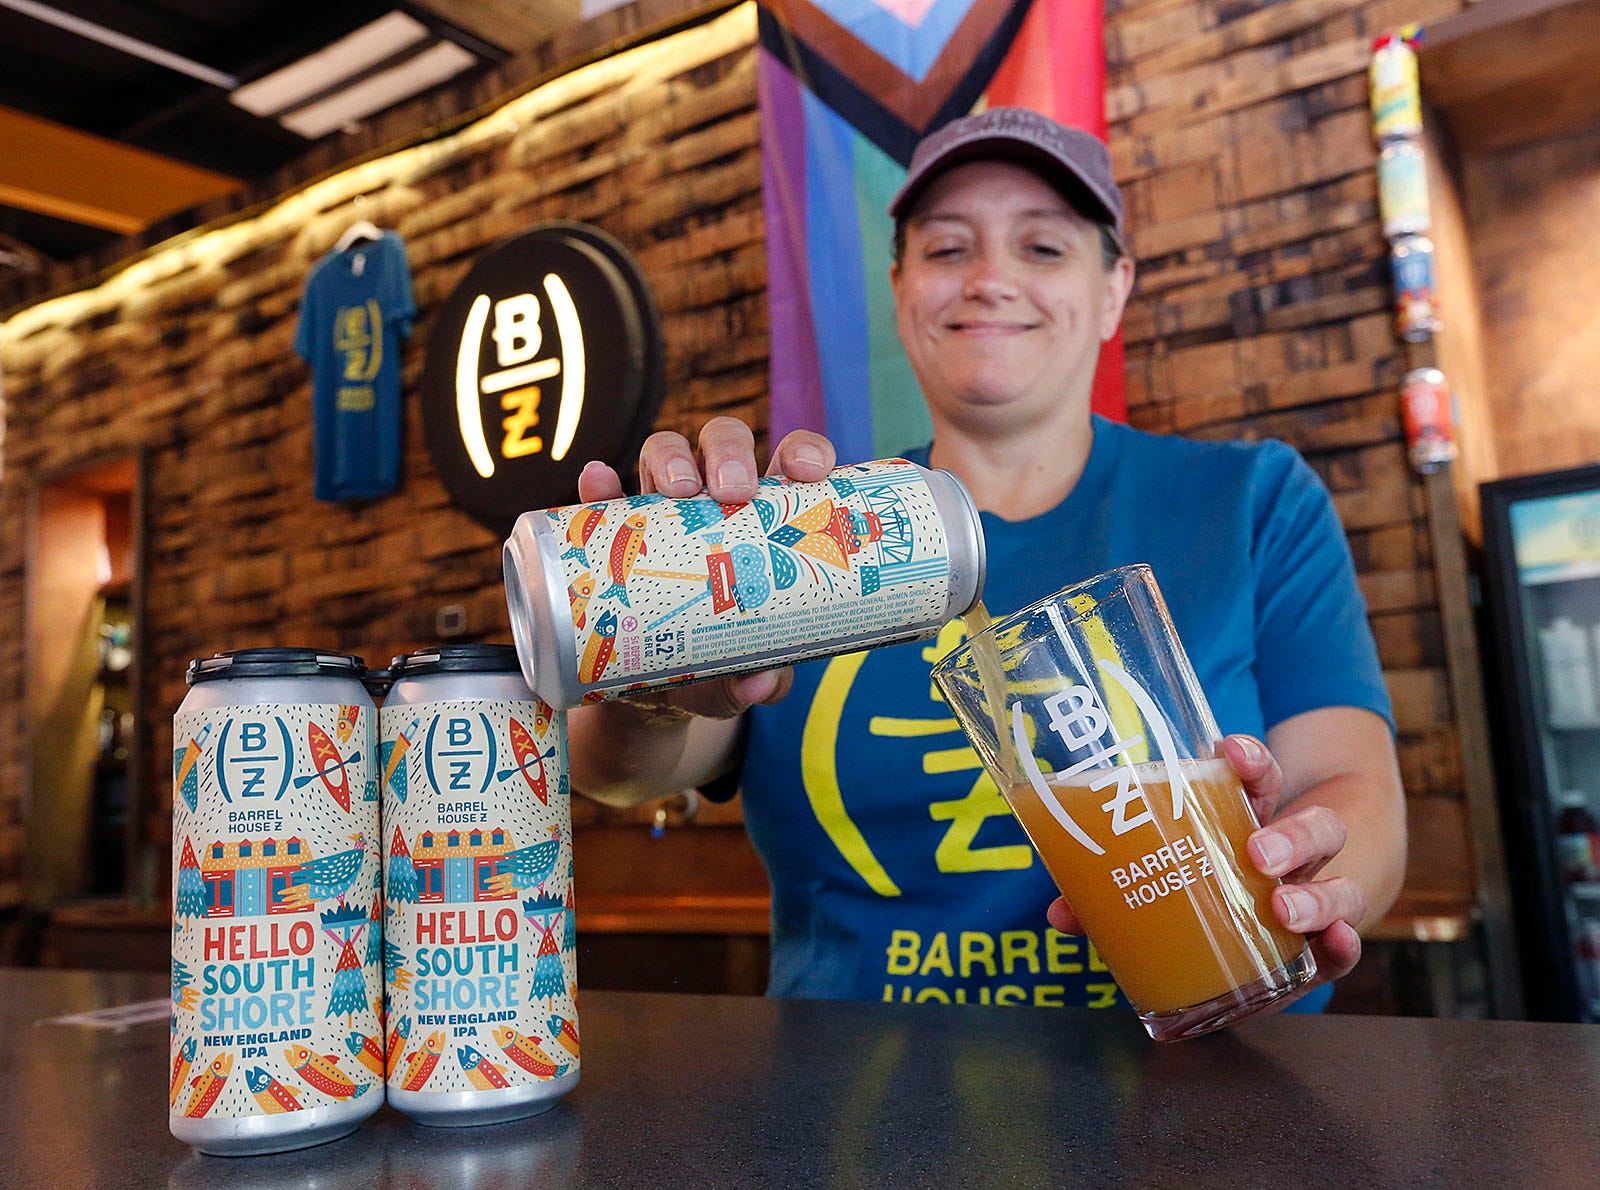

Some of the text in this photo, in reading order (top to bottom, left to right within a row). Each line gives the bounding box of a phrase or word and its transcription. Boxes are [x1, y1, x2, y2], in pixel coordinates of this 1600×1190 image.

[491, 292, 543, 367] B
[500, 386, 544, 460] Z
[692, 622, 735, 634] GOVERNMENT
[736, 616, 768, 626] WARNING:
[778, 609, 810, 619] ACCORDING
[832, 600, 858, 610] SURGEON
[860, 596, 885, 605] GENERAL,
[887, 592, 908, 601] WOMEN
[909, 588, 931, 597] SHOULD
[724, 627, 756, 637] ALCOHOLIC
[758, 620, 791, 632] BEVERAGES
[792, 617, 814, 626] DURING
[814, 610, 848, 621] PREGNANCY
[850, 606, 874, 616] BECAUSE
[692, 643, 709, 652] BIRTH
[711, 639, 736, 649] DEFECTS.
[748, 629, 789, 642] CONSUMPTION
[800, 622, 830, 632] ALCOHOLIC
[831, 616, 863, 626] BEVERAGES
[864, 613, 886, 622] IMPAIRS
[700, 650, 717, 658] DRIVE
[746, 640, 771, 650] OPERATE
[820, 628, 832, 636] MAY
[631, 646, 640, 670] DEPOSIT
[446, 718, 472, 746] B
[1043, 684, 1109, 752] B
[240, 723, 267, 751] B
[242, 768, 265, 797] Z
[449, 762, 471, 789] Z
[228, 809, 283, 822] BARREL
[438, 802, 488, 813] BARREL
[1089, 767, 1153, 836] Z
[228, 822, 282, 834] HOUSE Z
[438, 813, 488, 824] HOUSE Z
[1110, 834, 1205, 890] BARREL
[1123, 857, 1214, 910] HOUSE Z
[204, 921, 315, 961] HELLO
[416, 908, 518, 945] HELLO
[415, 943, 518, 977] SOUTH
[202, 957, 315, 996] SOUTH
[414, 974, 520, 1011] SHORE
[200, 990, 316, 1032] SHORE
[418, 1010, 518, 1025] NEW ENGLAND
[204, 1028, 312, 1046] NEW ENGLAND
[453, 1026, 478, 1037] IPA
[242, 1046, 268, 1058] IPA
